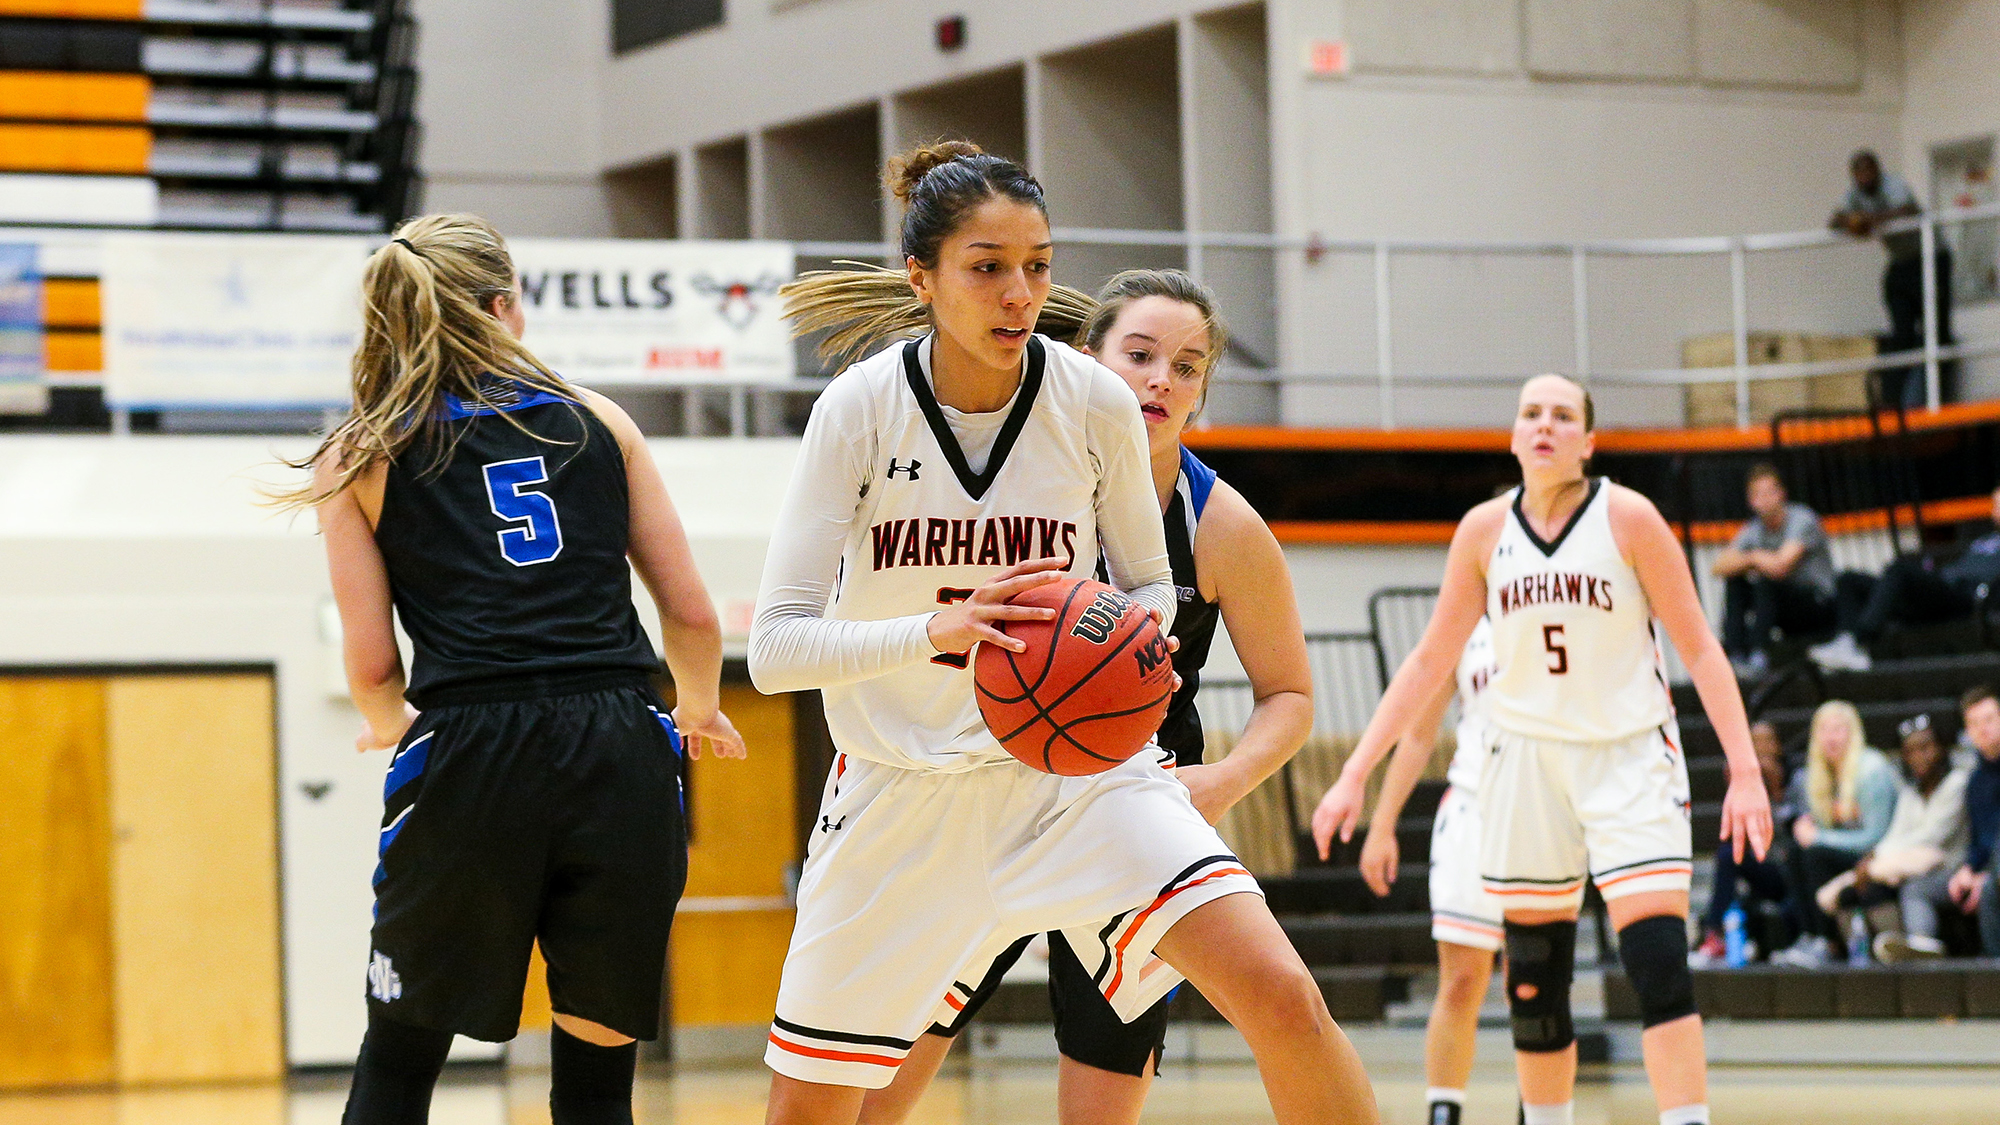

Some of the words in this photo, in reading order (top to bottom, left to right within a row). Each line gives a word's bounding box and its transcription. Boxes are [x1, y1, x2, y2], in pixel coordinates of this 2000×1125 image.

[482, 456, 563, 567] 5
[871, 516, 1077, 573] WARHAWKS
[1498, 572, 1613, 616] WARHAWKS
[1542, 623, 1569, 676] 5
